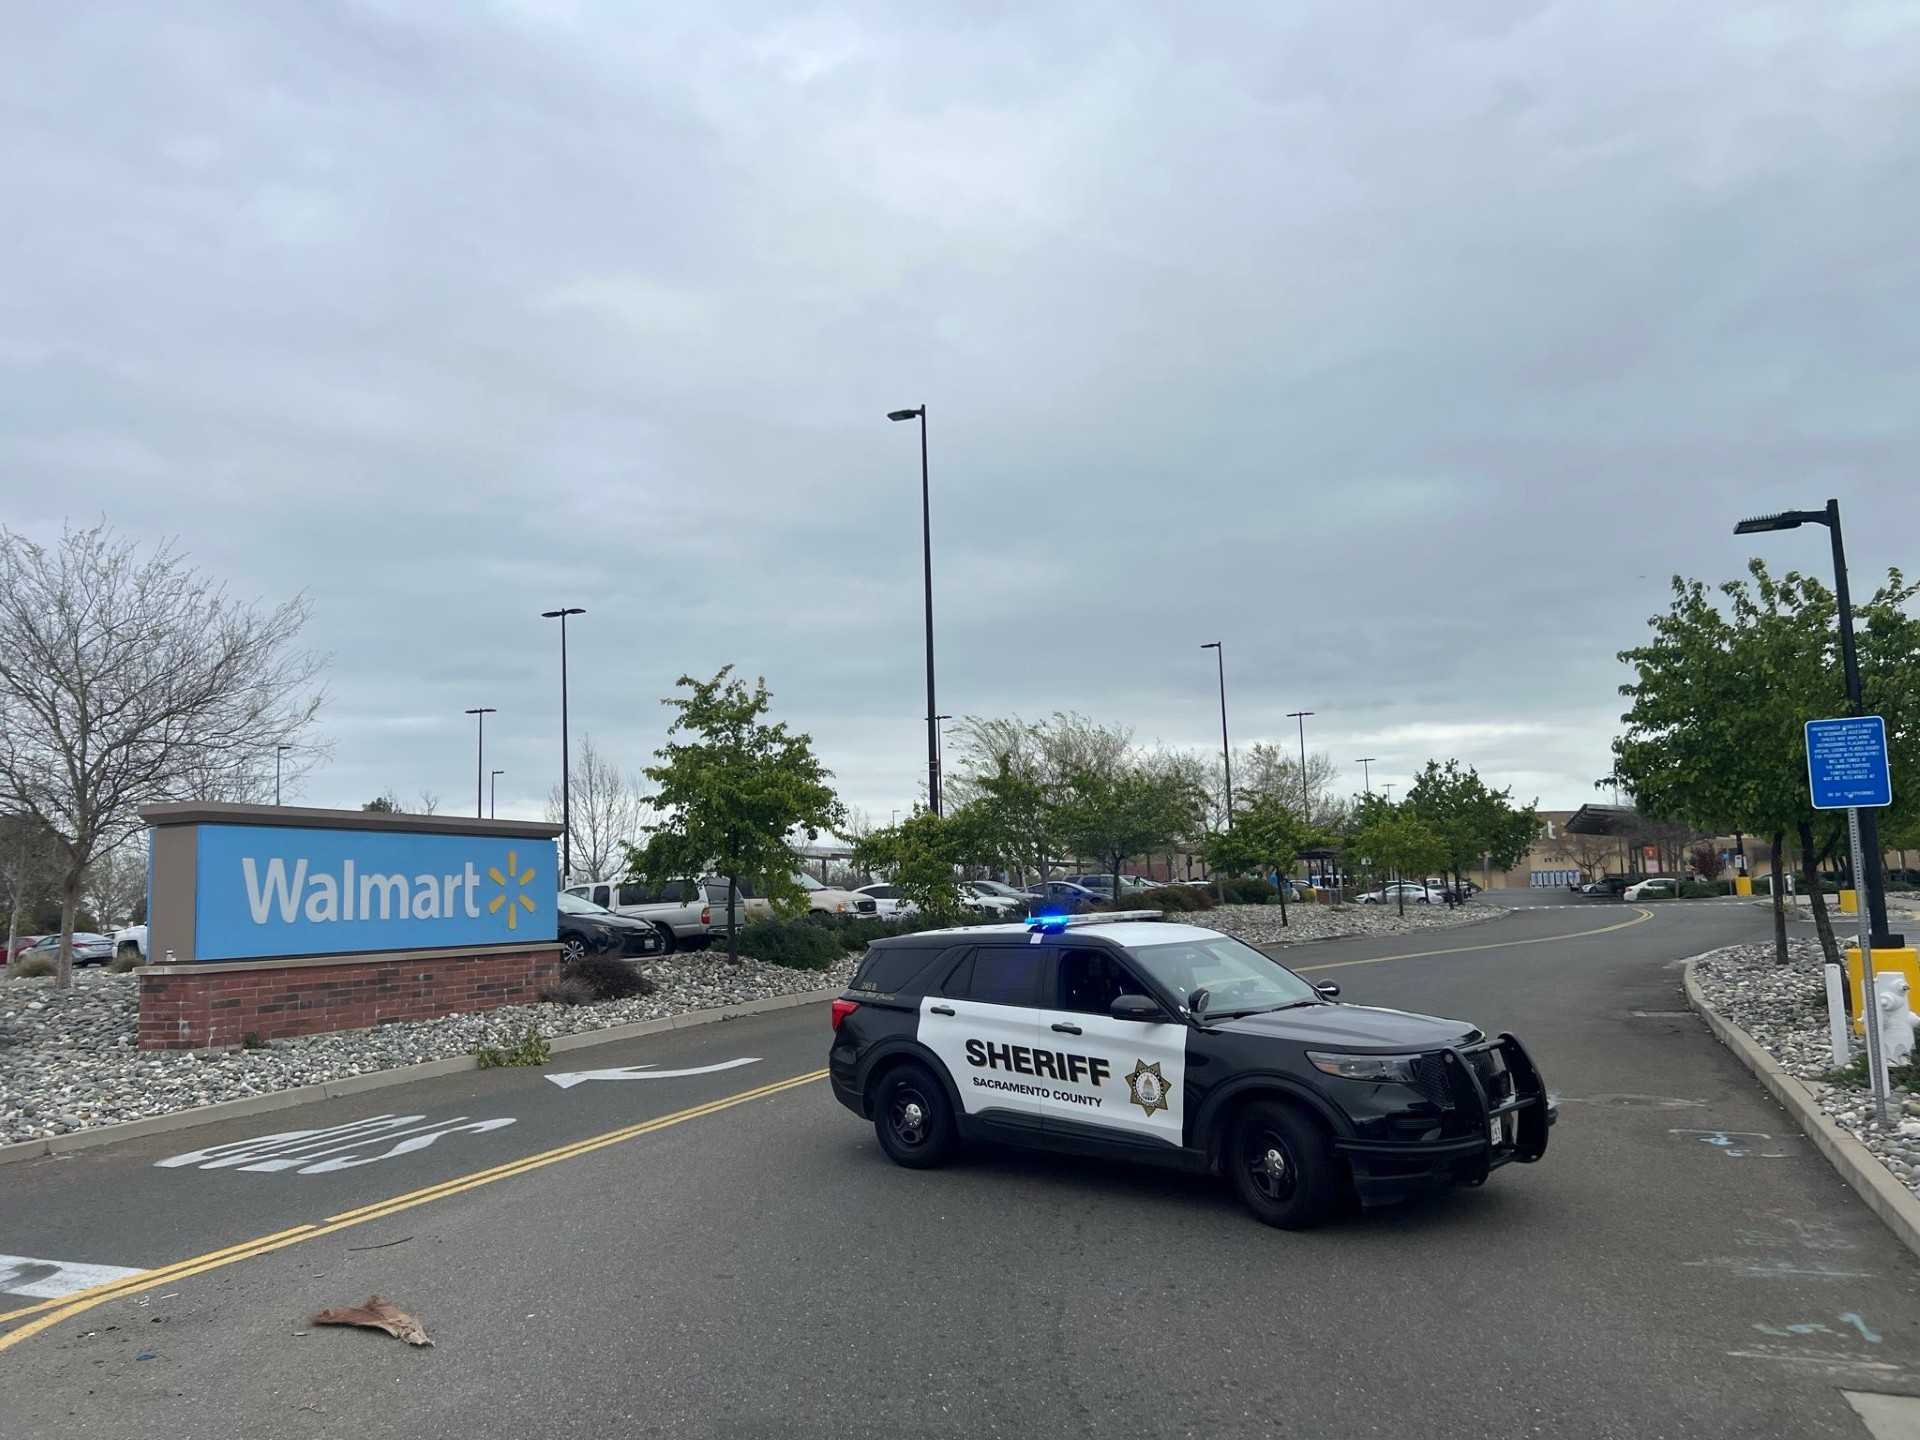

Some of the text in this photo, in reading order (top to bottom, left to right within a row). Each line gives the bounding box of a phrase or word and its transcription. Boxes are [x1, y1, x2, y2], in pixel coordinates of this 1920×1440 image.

[241, 857, 480, 925] Walmart
[965, 1038, 1111, 1087] SHERIFF
[973, 1076, 1103, 1108] SACRAMENTO COUNTY
[153, 1114, 518, 1175] STOP
